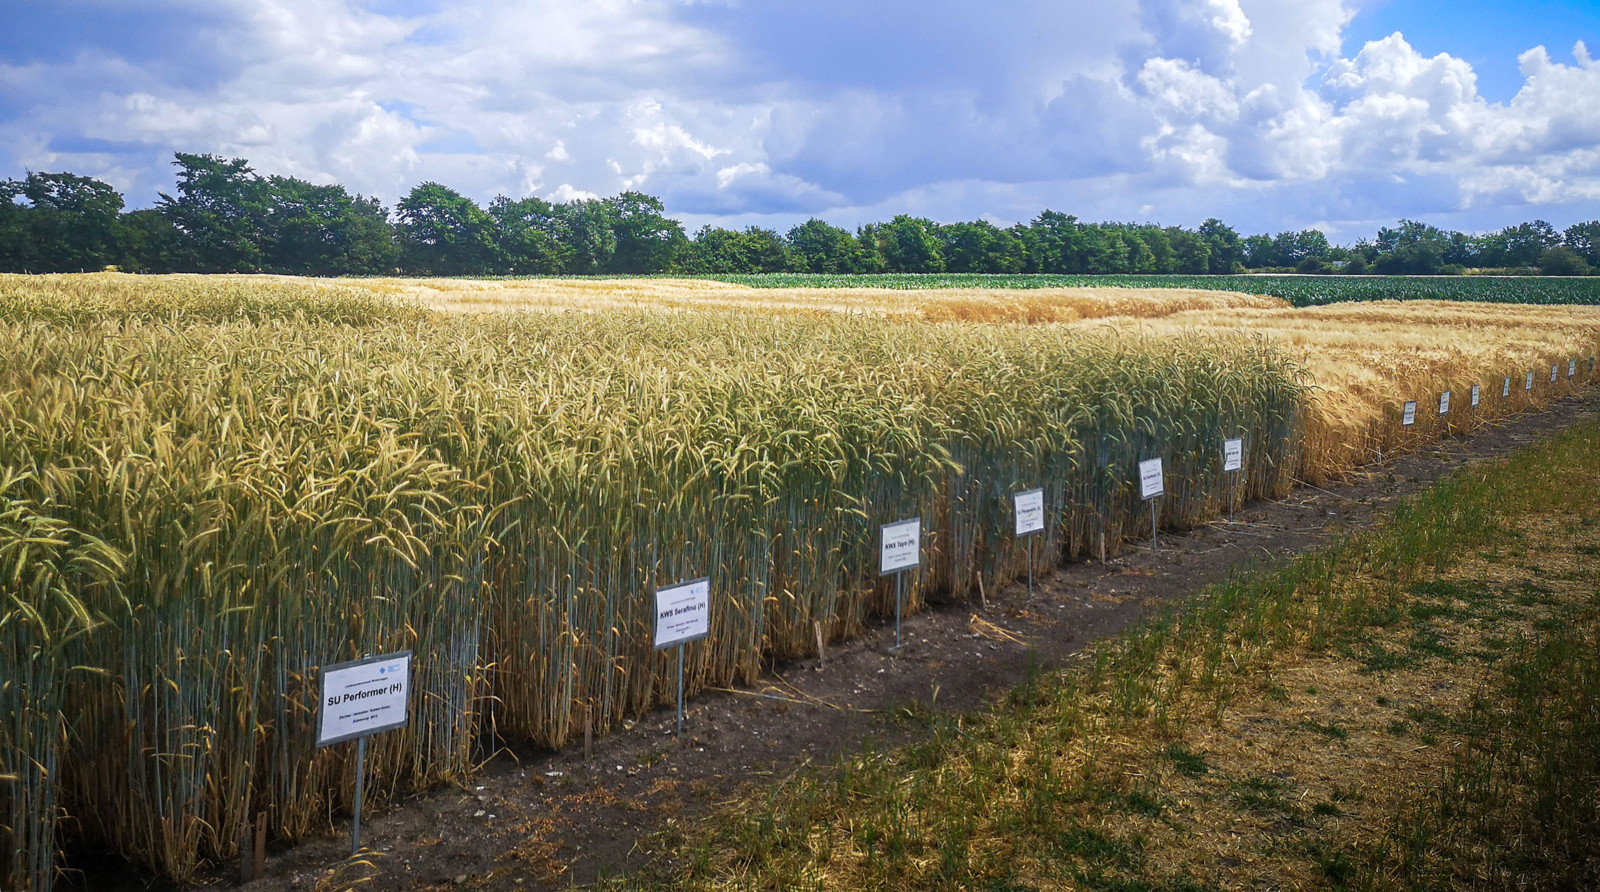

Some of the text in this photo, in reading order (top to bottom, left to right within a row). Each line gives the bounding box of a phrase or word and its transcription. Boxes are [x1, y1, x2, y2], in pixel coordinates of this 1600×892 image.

[660, 602, 706, 619] KWS Serafino (H)
[327, 696, 341, 706] SU
[343, 687, 388, 703] Performer
[389, 682, 402, 695] (H)
